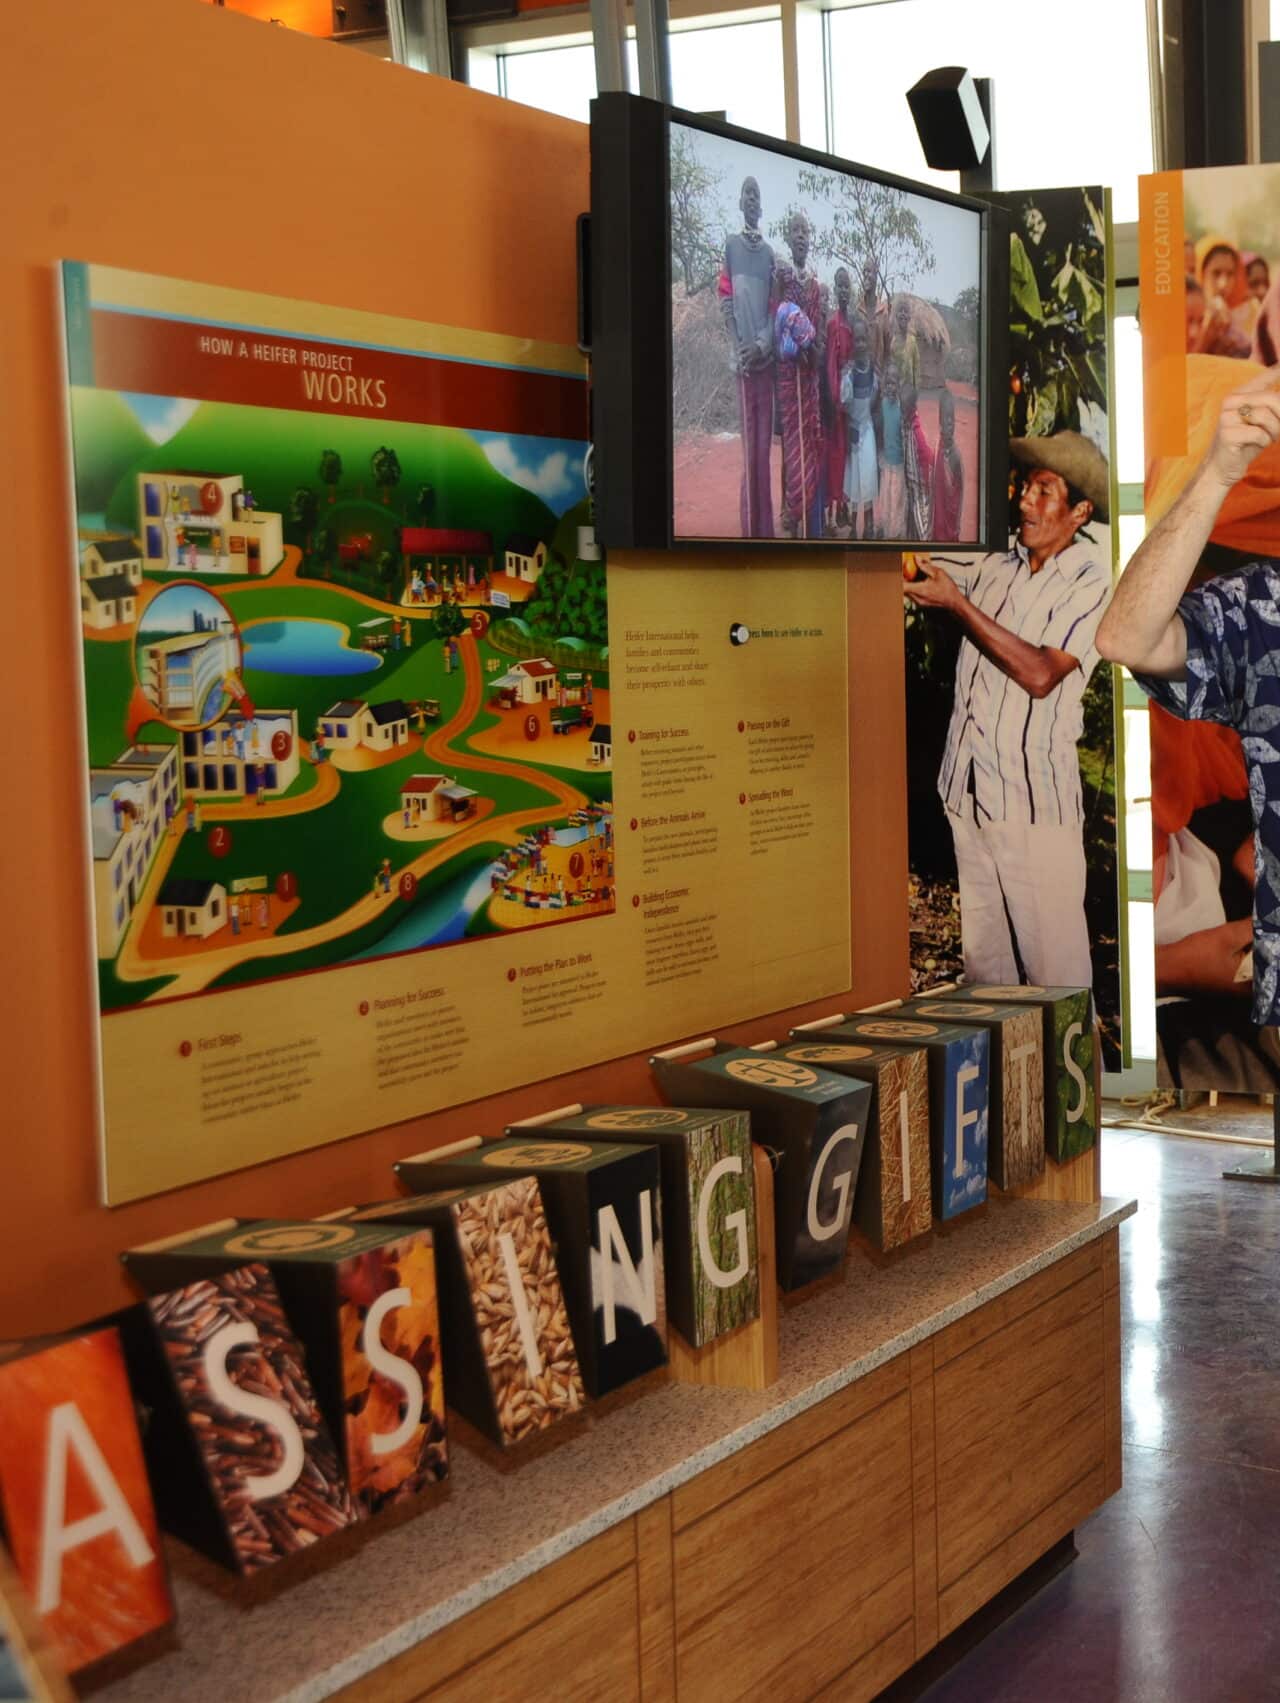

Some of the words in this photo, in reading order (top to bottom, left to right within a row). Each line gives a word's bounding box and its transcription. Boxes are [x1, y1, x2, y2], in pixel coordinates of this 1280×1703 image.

[1155, 190, 1169, 295] EDUCATION
[200, 336, 234, 356] HOW
[239, 341, 248, 357] A
[254, 344, 297, 364] HEIFER
[303, 350, 352, 372] PROJECT
[303, 370, 387, 408] WORKS
[208, 483, 216, 502] 4
[475, 612, 482, 630] 5
[278, 732, 286, 750] 3
[216, 827, 225, 847] 2
